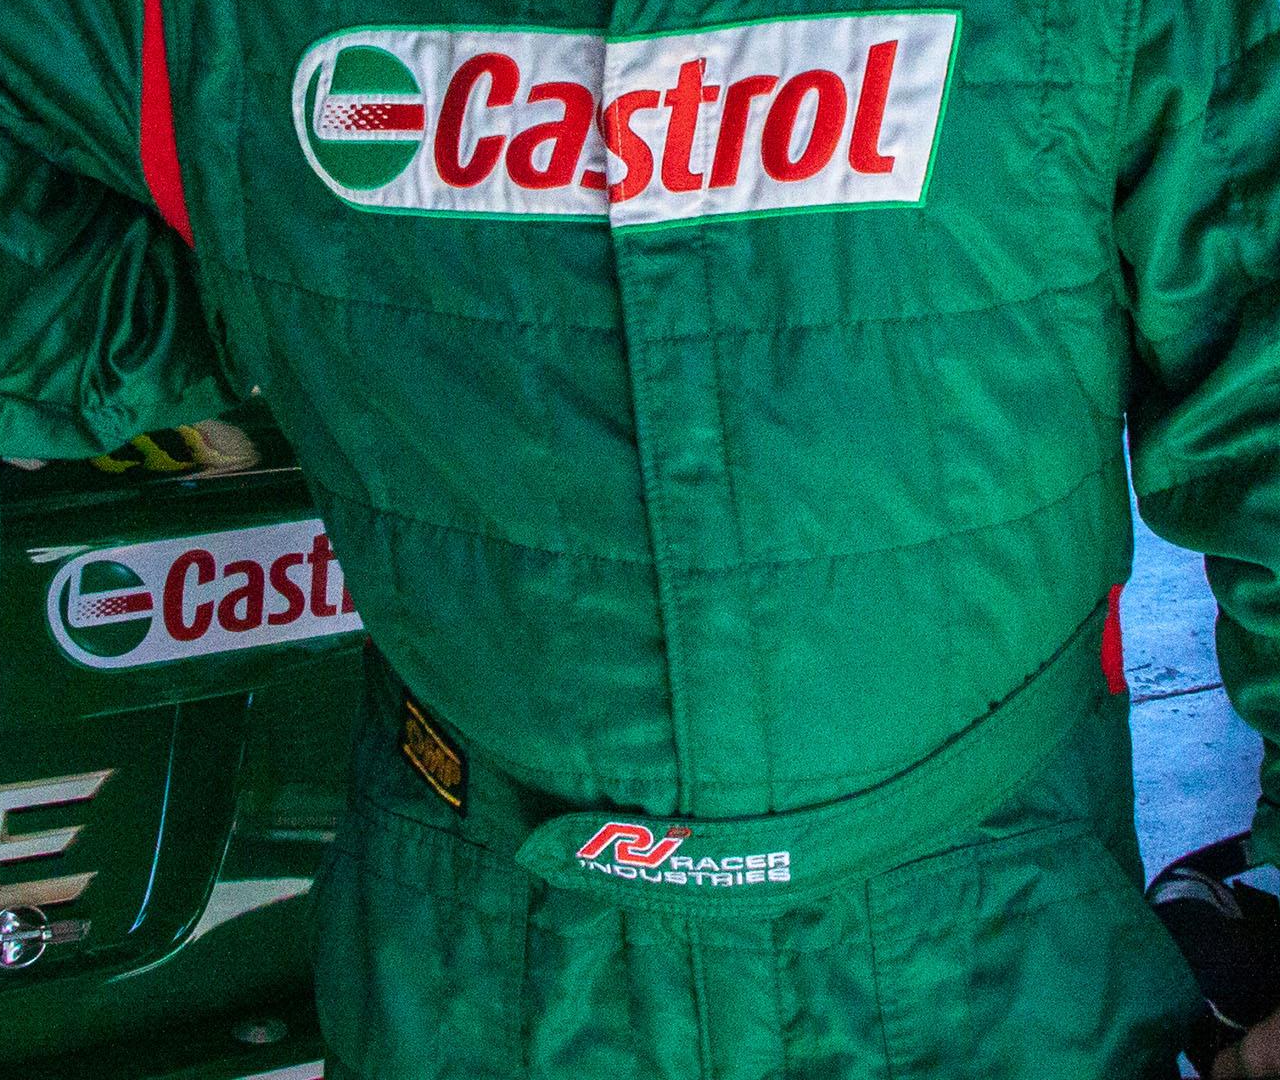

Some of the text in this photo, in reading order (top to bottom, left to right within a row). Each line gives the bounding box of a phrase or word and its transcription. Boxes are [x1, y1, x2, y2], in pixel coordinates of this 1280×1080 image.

[433, 40, 899, 203] Castrol
[163, 532, 357, 642] Cast
[579, 860, 791, 887] INDUSTRIES
[671, 851, 790, 871] RACER
